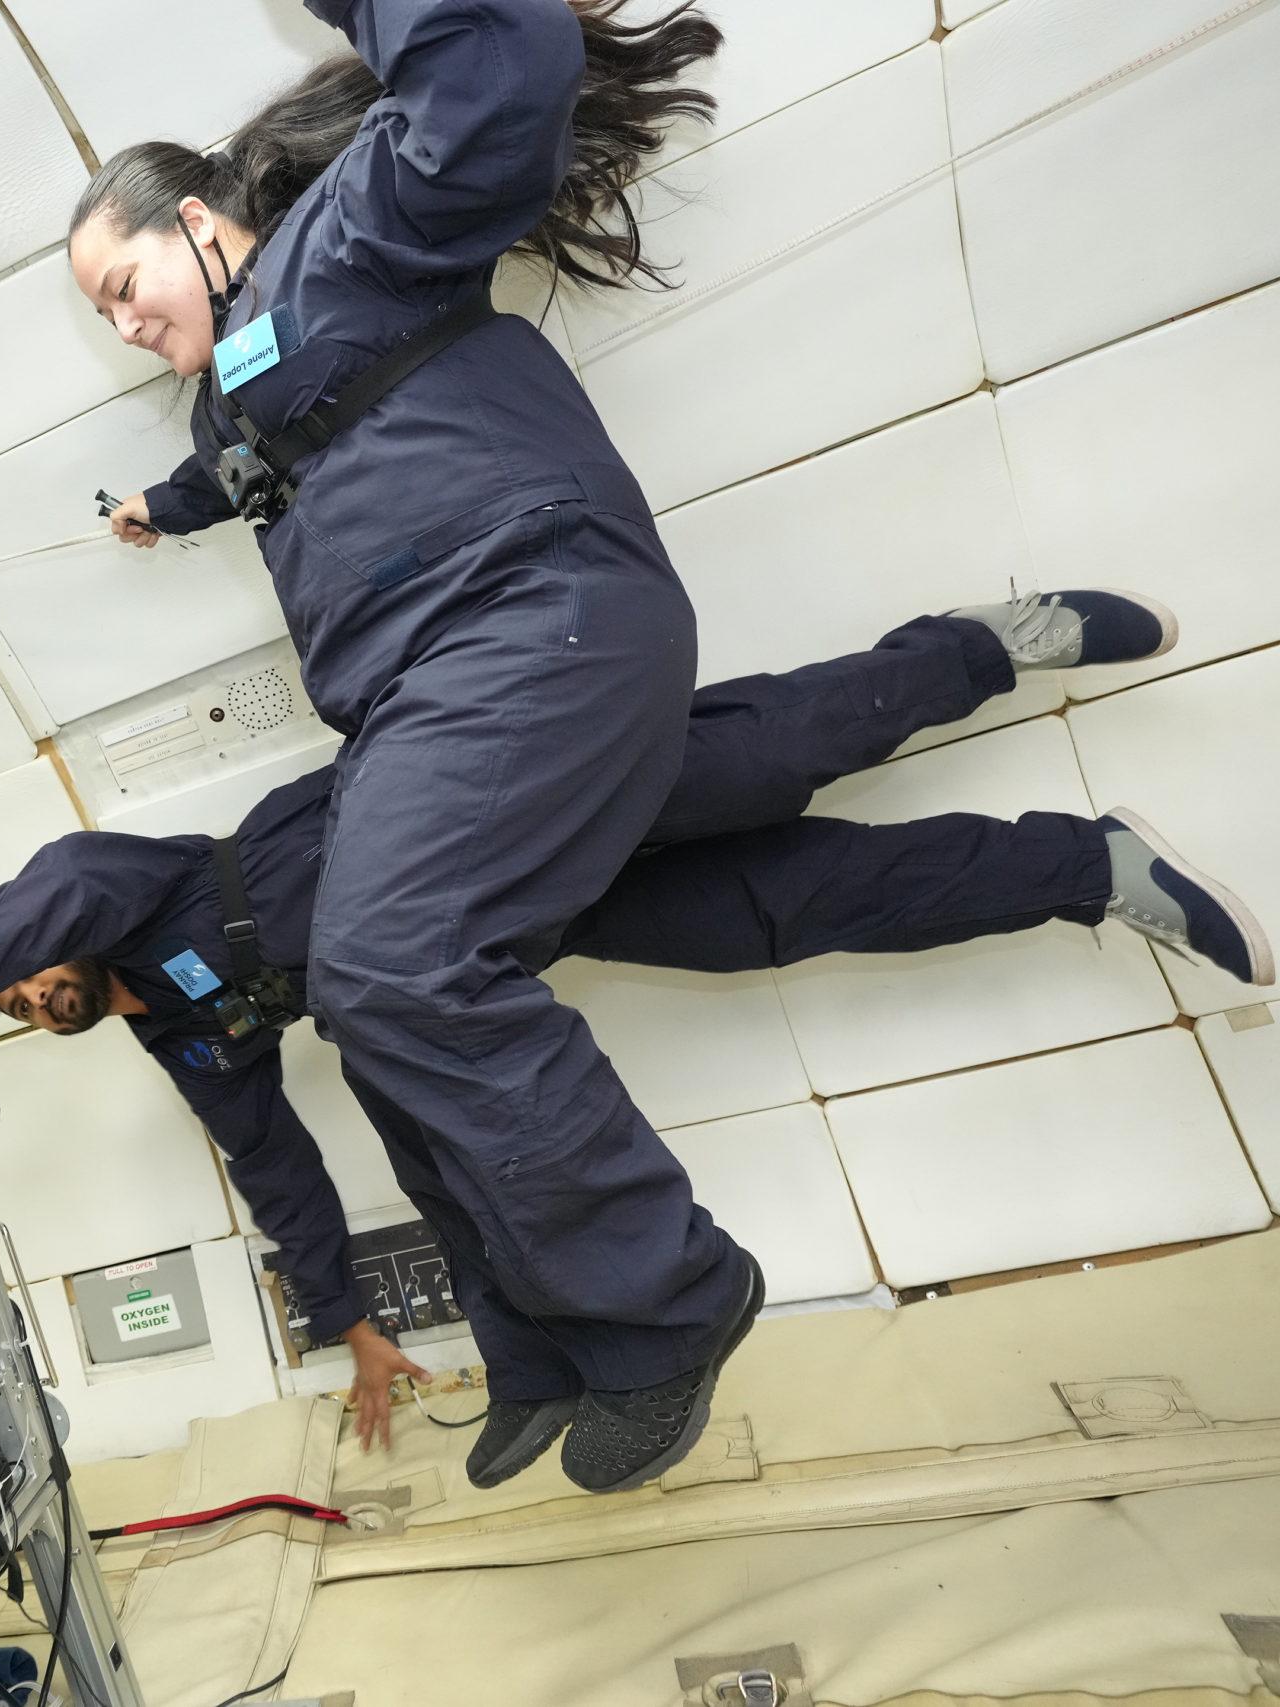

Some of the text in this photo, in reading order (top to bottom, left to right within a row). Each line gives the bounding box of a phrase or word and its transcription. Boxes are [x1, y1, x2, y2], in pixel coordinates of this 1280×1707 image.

[222, 345, 274, 381] Arlene Lopez
[173, 970, 195, 993] PRANAY
[180, 968, 198, 986] DOSHI
[135, 1261, 153, 1270] OPEN
[121, 1303, 170, 1321] OXYGEN
[128, 1315, 169, 1332] INSIDE
